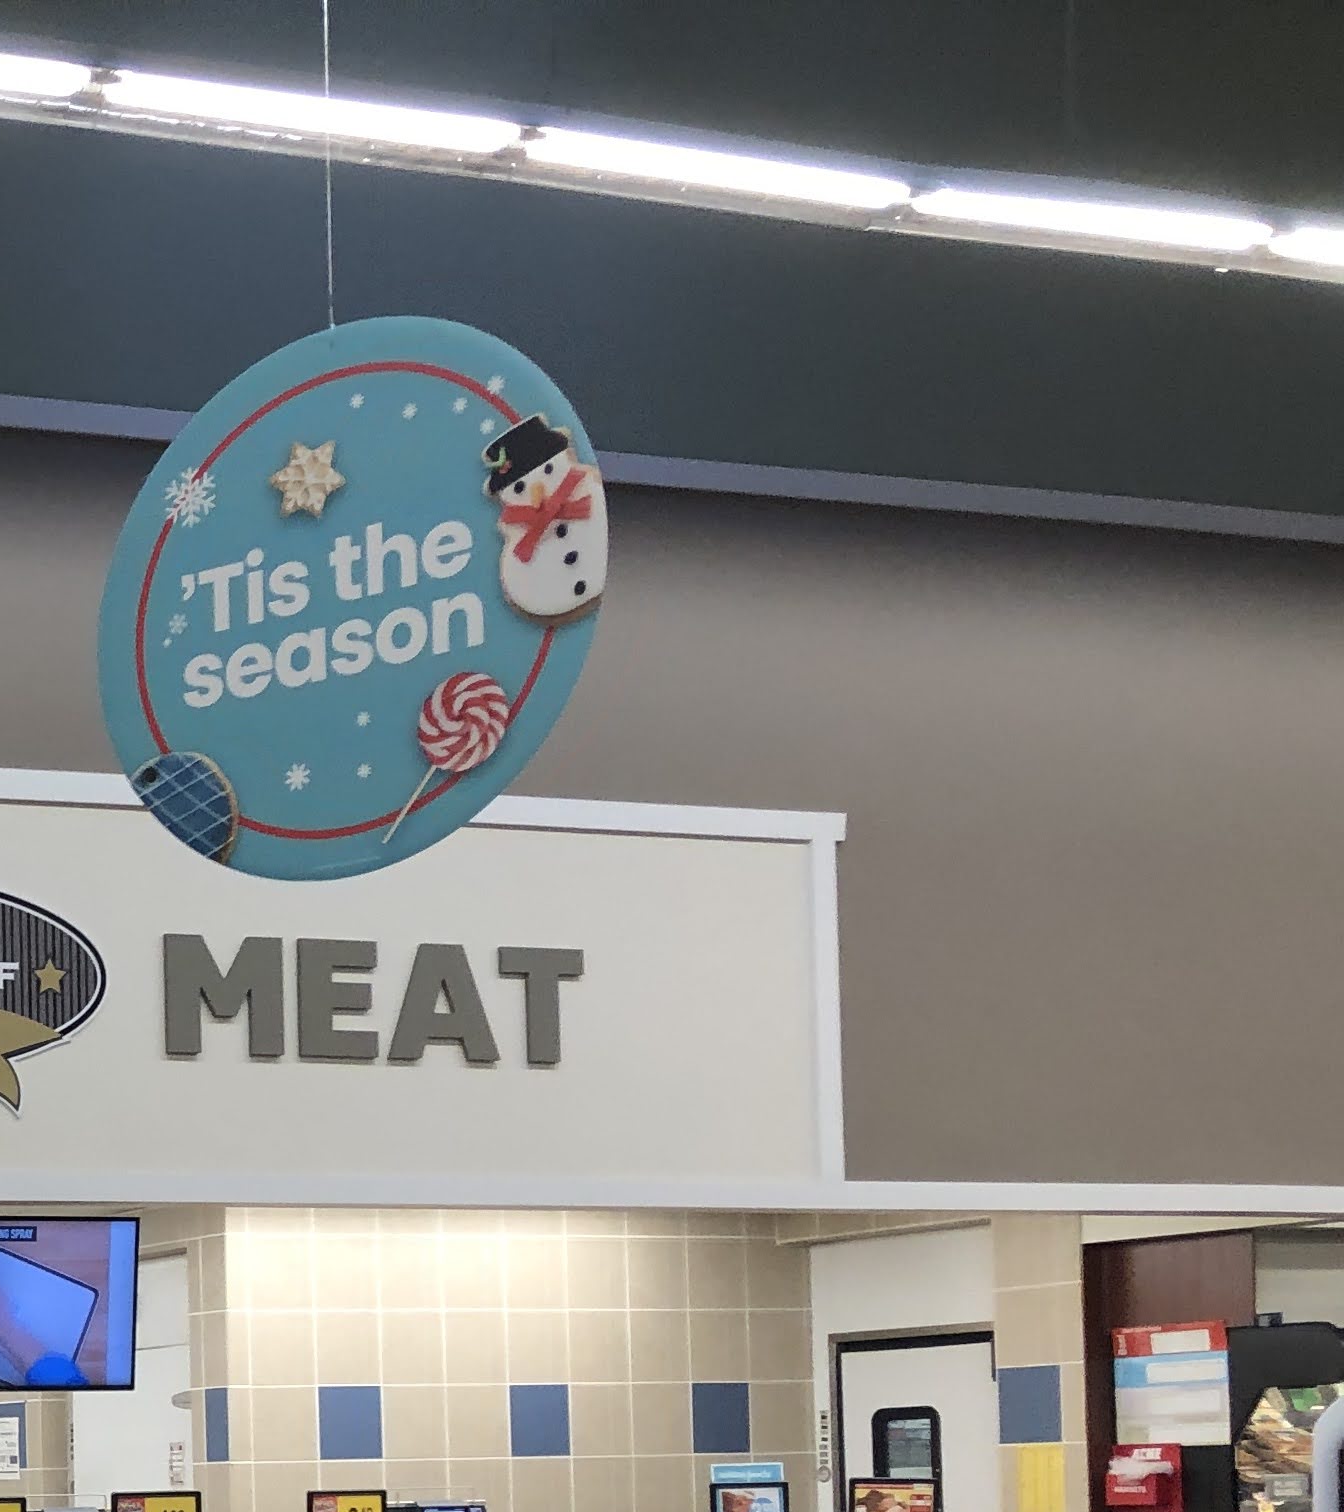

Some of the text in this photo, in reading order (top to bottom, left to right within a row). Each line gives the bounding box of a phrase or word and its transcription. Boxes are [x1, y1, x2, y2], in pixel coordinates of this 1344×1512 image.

[181, 520, 473, 634] 'Tis the
[183, 592, 485, 709] season
[162, 933, 583, 1068] MEAT
[11, 1228, 33, 1239] SPRAY
